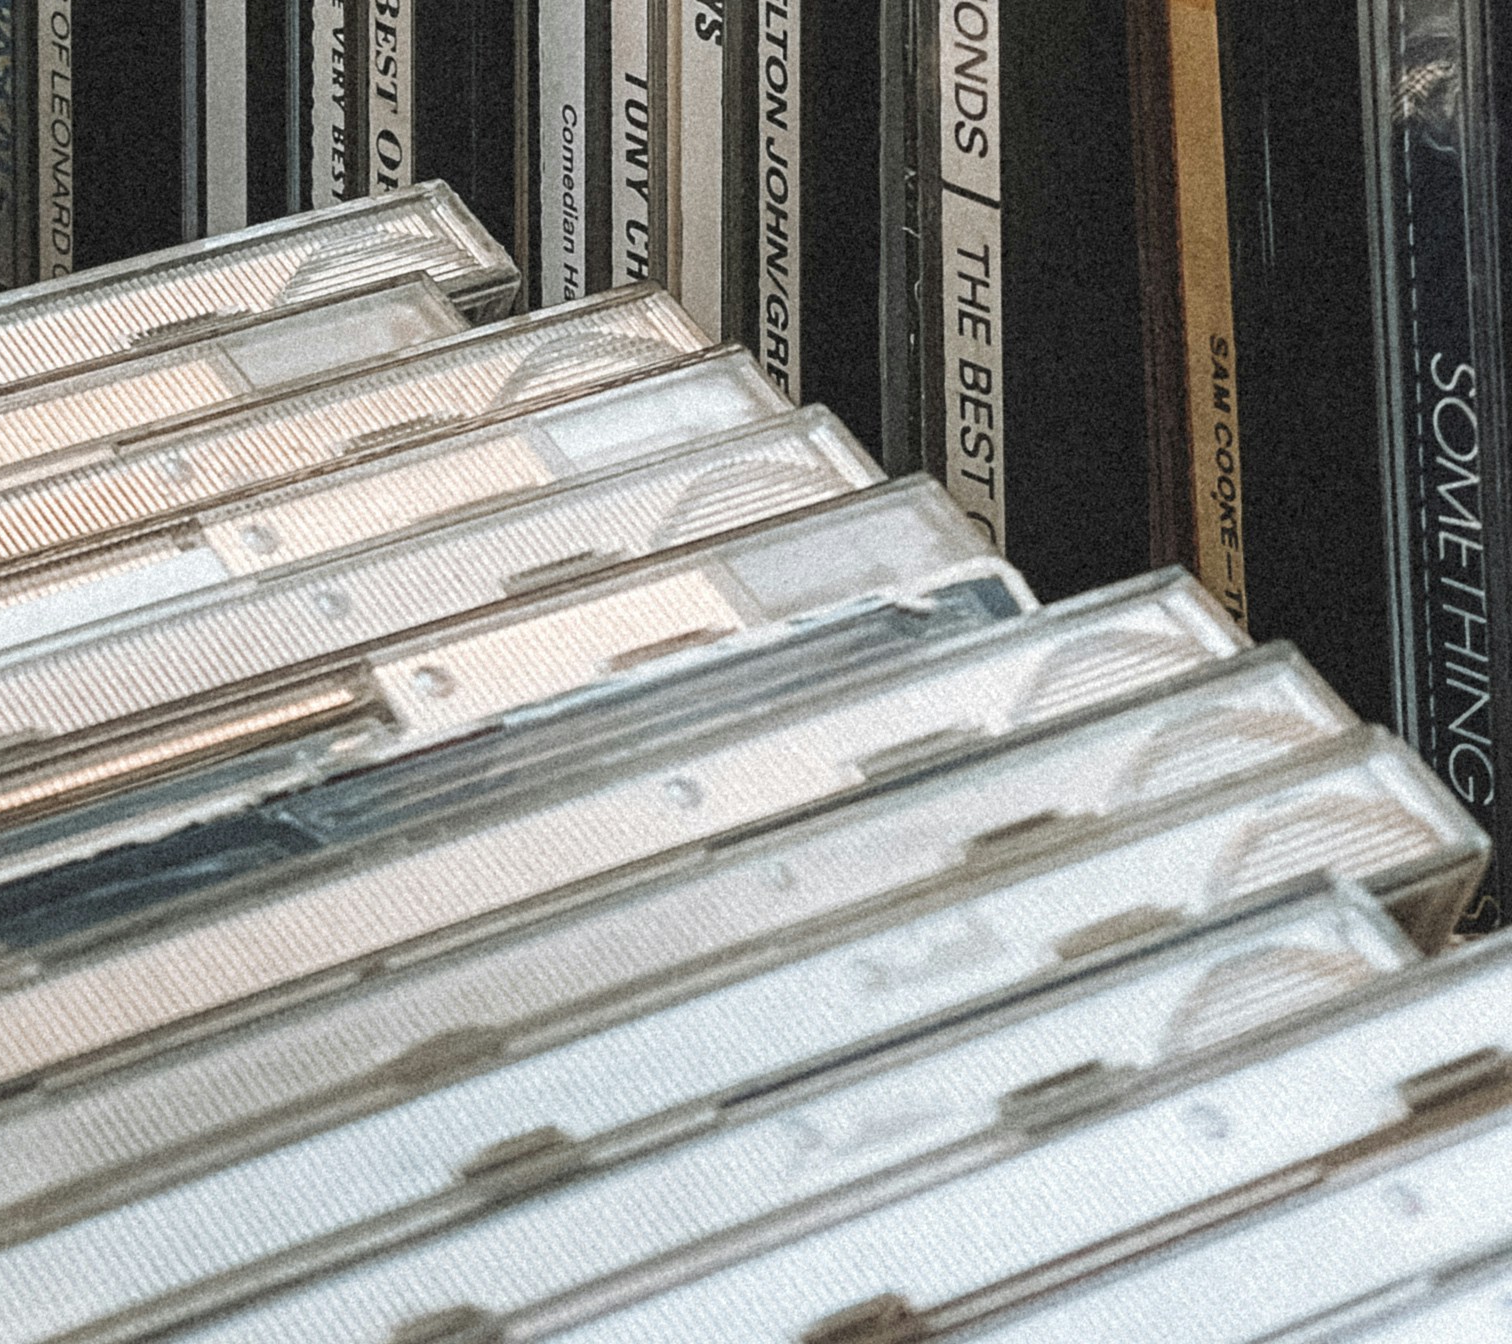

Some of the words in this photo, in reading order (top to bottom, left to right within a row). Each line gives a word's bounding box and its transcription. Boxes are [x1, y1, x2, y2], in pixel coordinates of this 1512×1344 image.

[48, 9, 72, 52] OF
[48, 52, 72, 254] LEONARD
[562, 104, 578, 254] Comedian
[956, 241, 992, 355] THE
[960, 361, 994, 502] BEST
[1208, 334, 1233, 424] SAM
[1431, 352, 1494, 807] SOMETHING
